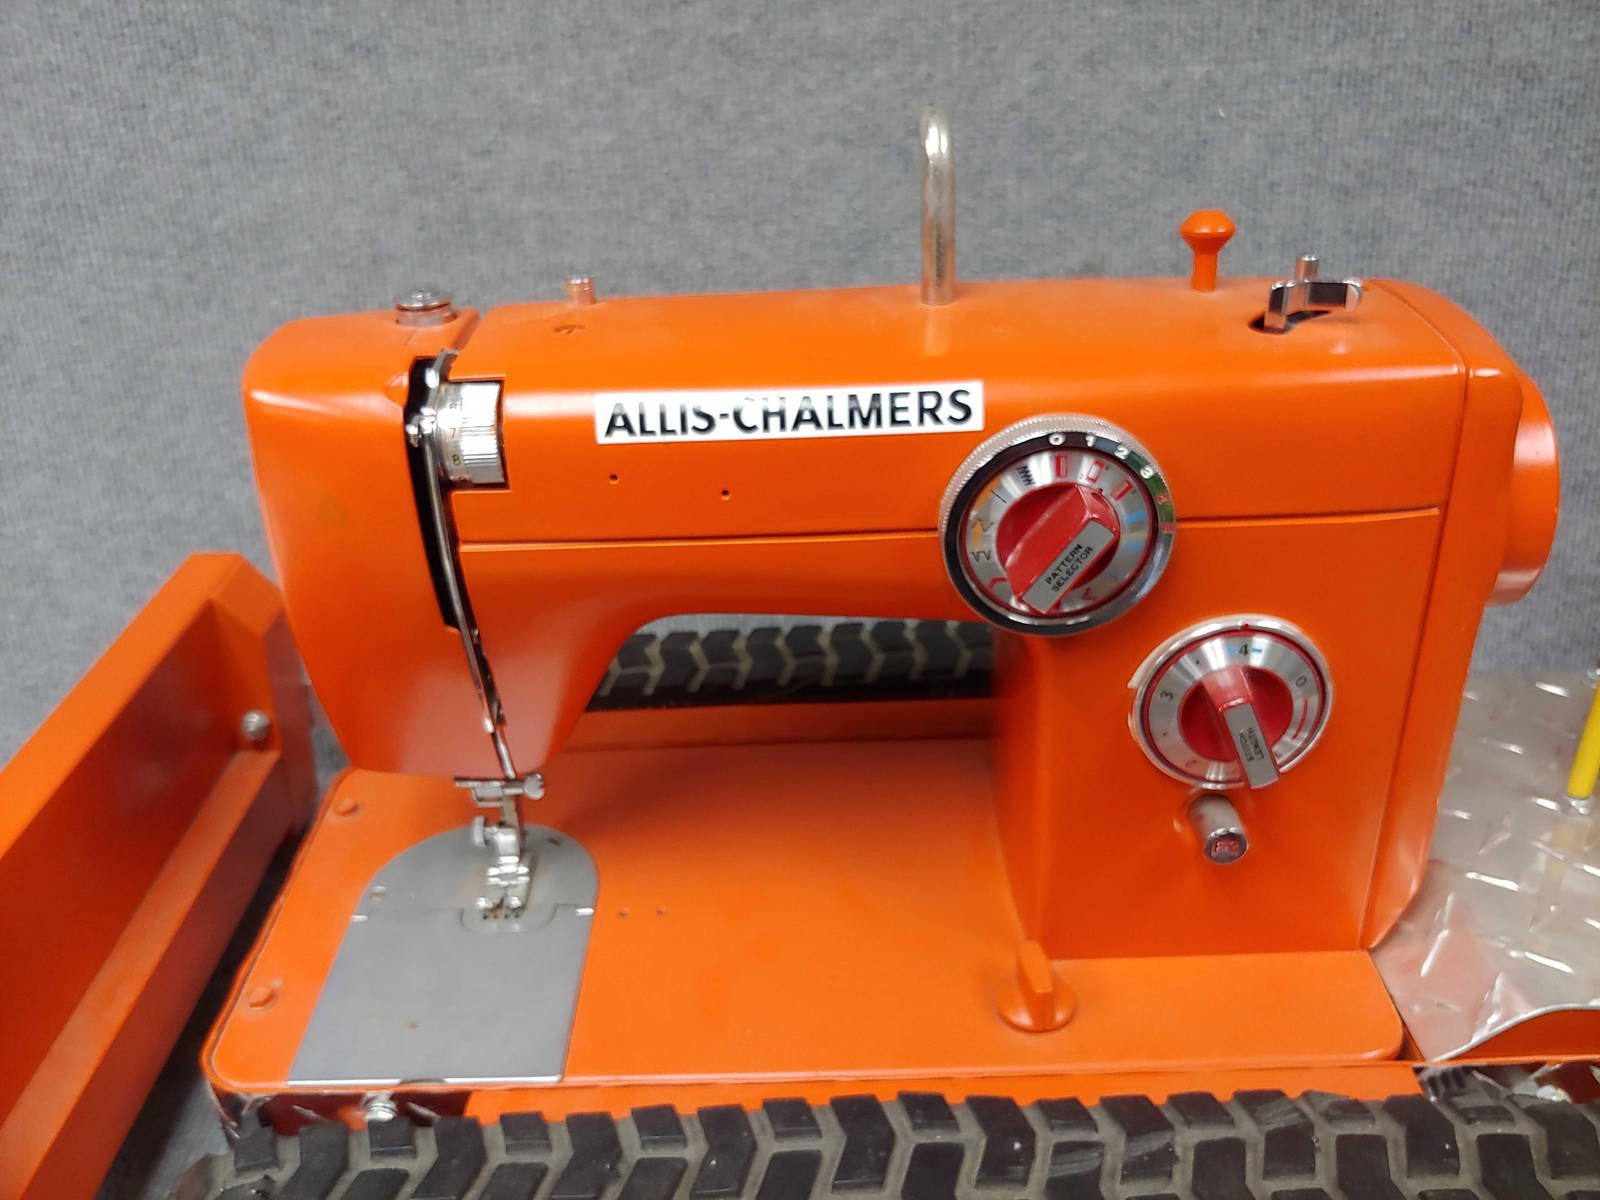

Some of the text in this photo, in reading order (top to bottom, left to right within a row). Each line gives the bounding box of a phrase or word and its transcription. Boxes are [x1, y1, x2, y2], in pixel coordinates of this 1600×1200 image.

[604, 388, 973, 438] ALLIS-CHALMERS
[1114, 446, 1129, 460] 2
[1139, 466, 1155, 479] 3
[1044, 543, 1084, 586] PATTERN
[1050, 546, 1094, 594] SELECTOR
[1238, 643, 1249, 656] 4
